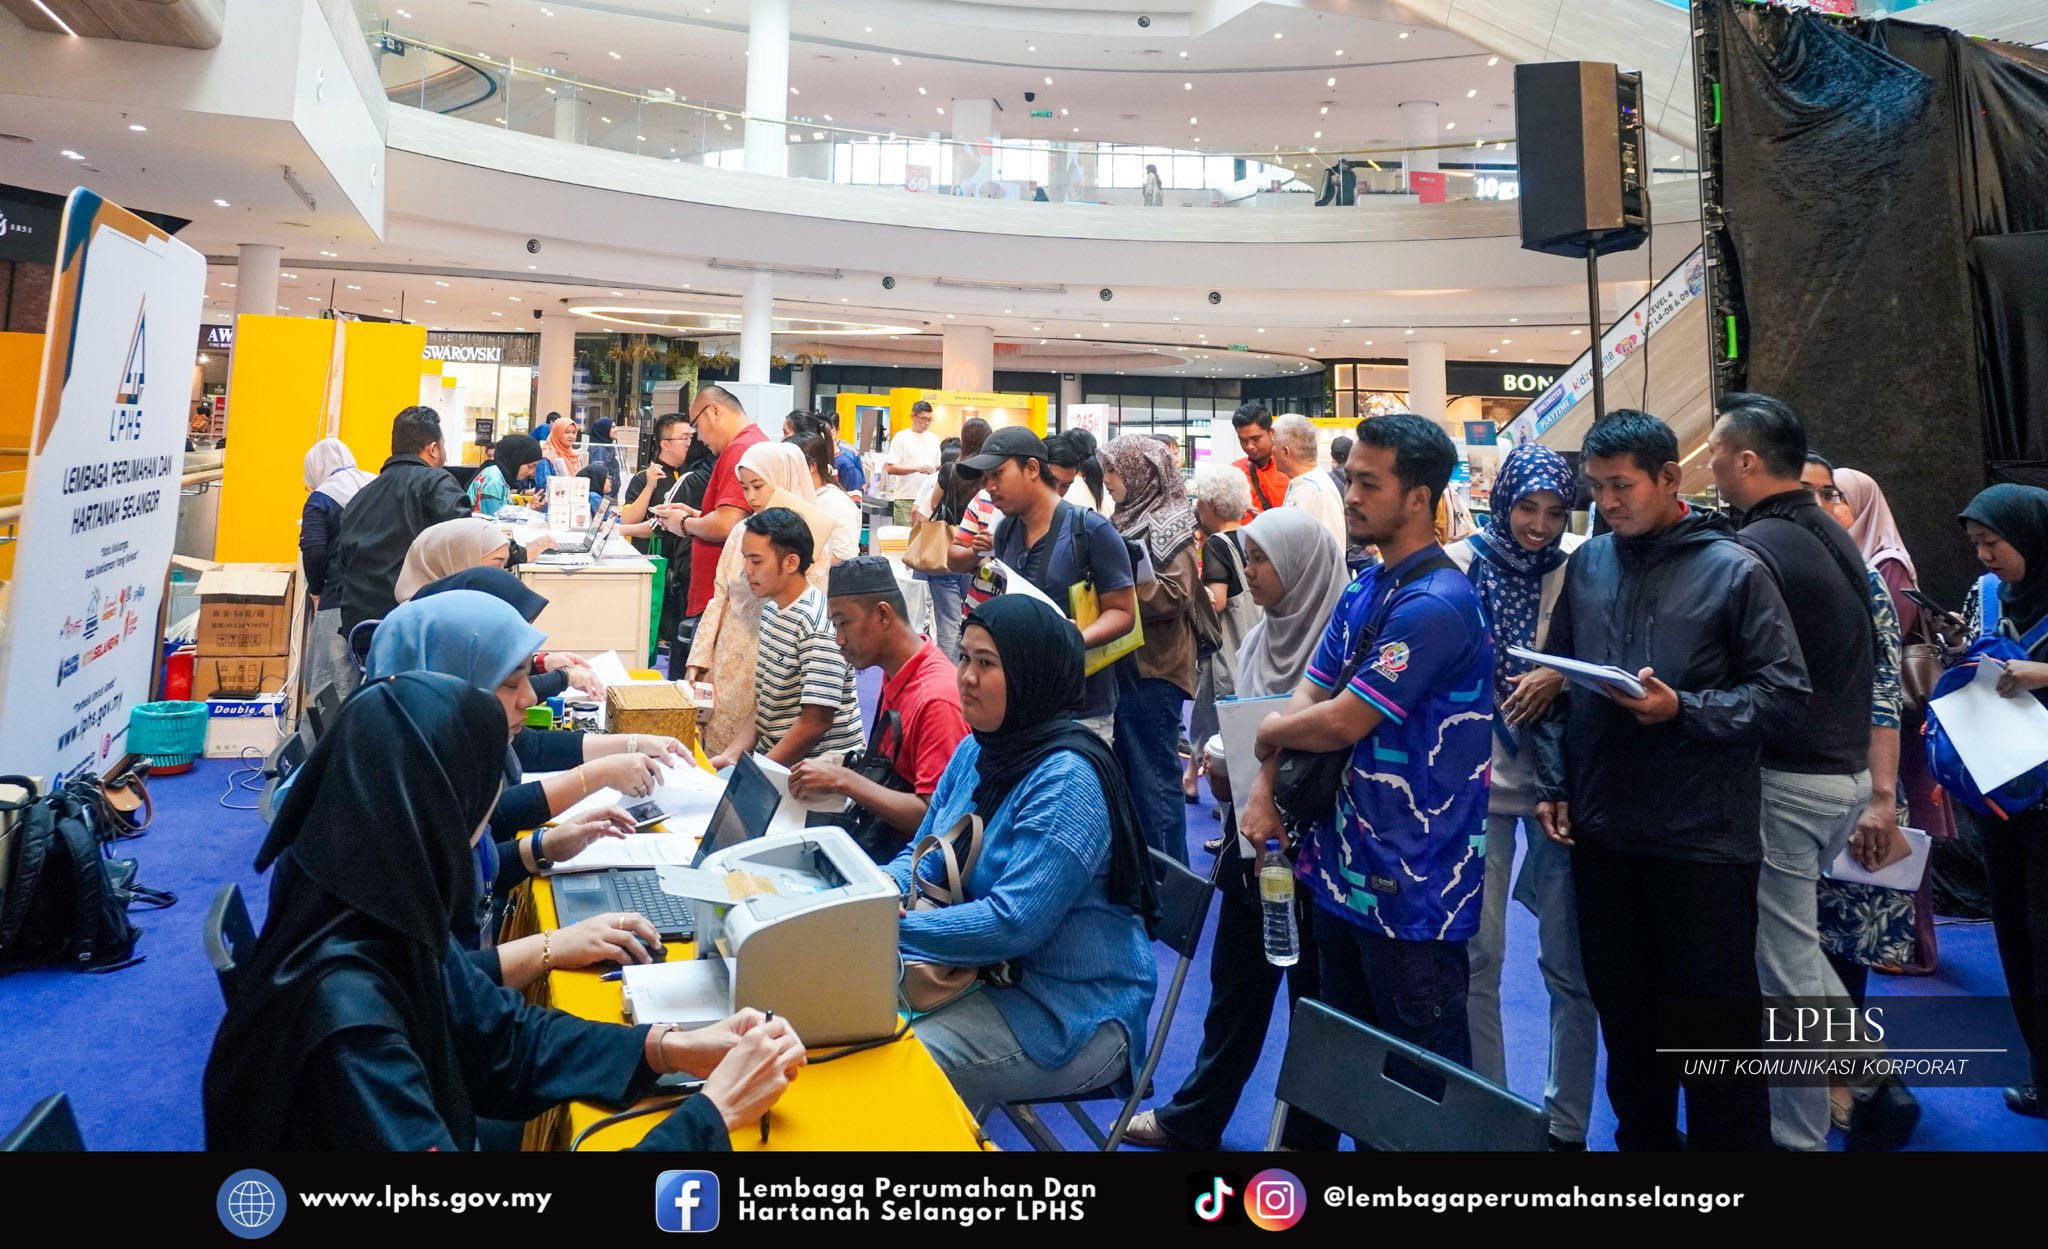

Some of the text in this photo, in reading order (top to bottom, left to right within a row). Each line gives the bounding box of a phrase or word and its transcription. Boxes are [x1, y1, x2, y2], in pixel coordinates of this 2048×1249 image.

[1648, 290, 1673, 316] LEVEL 4
[1654, 303, 1675, 323] L4-08
[1674, 299, 1681, 307] &
[1680, 289, 1690, 301] 09
[423, 345, 501, 361] SWAROVSKI
[109, 409, 142, 442] LPHS
[63, 455, 173, 495] LEMBAGA PERUMAHAN DAN
[71, 490, 160, 535] HARTANAH SELANGOR
[57, 691, 124, 752] www.lphs.gov.my
[214, 705, 256, 714] Double
